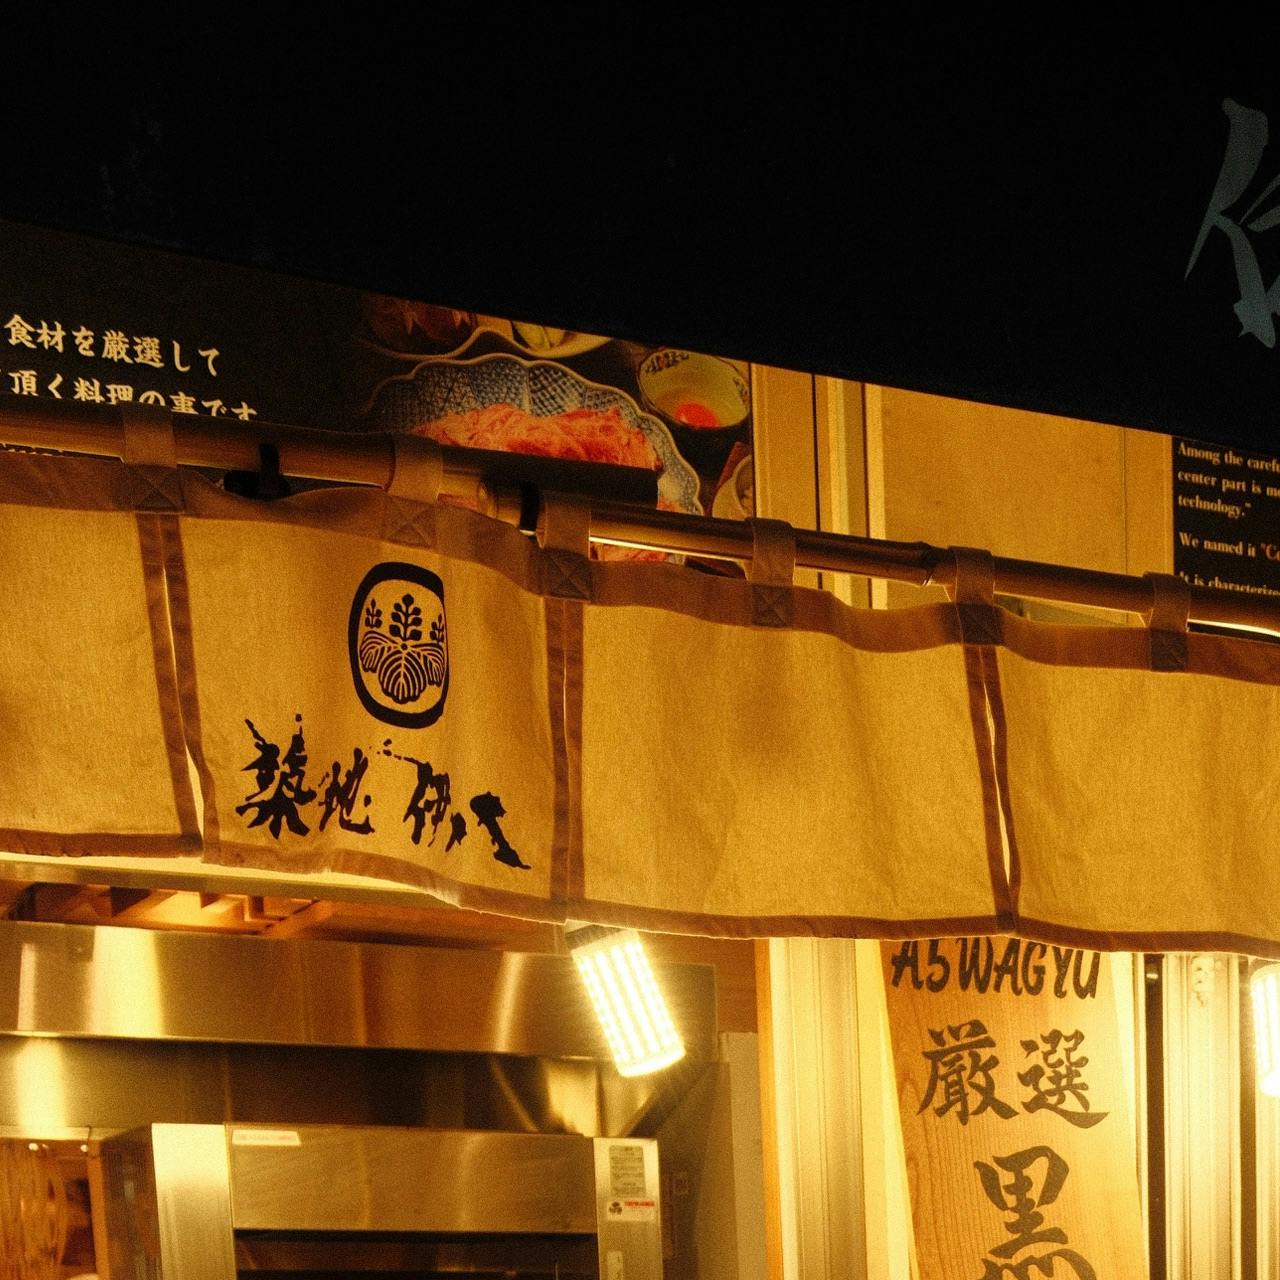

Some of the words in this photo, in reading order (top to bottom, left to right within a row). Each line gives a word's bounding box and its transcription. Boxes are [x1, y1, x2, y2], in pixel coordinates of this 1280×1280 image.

[4, 313, 221, 377] 食材を厳選して
[1178, 441, 1221, 465] Among
[1224, 450, 1243, 466] the
[1178, 471, 1217, 487] center
[1221, 477, 1246, 493] part
[1251, 480, 1262, 494] is
[1179, 532, 1199, 547] We
[1203, 540, 1243, 556] named
[1248, 543, 1256, 557] it
[916, 1019, 1109, 1129] 厳選
